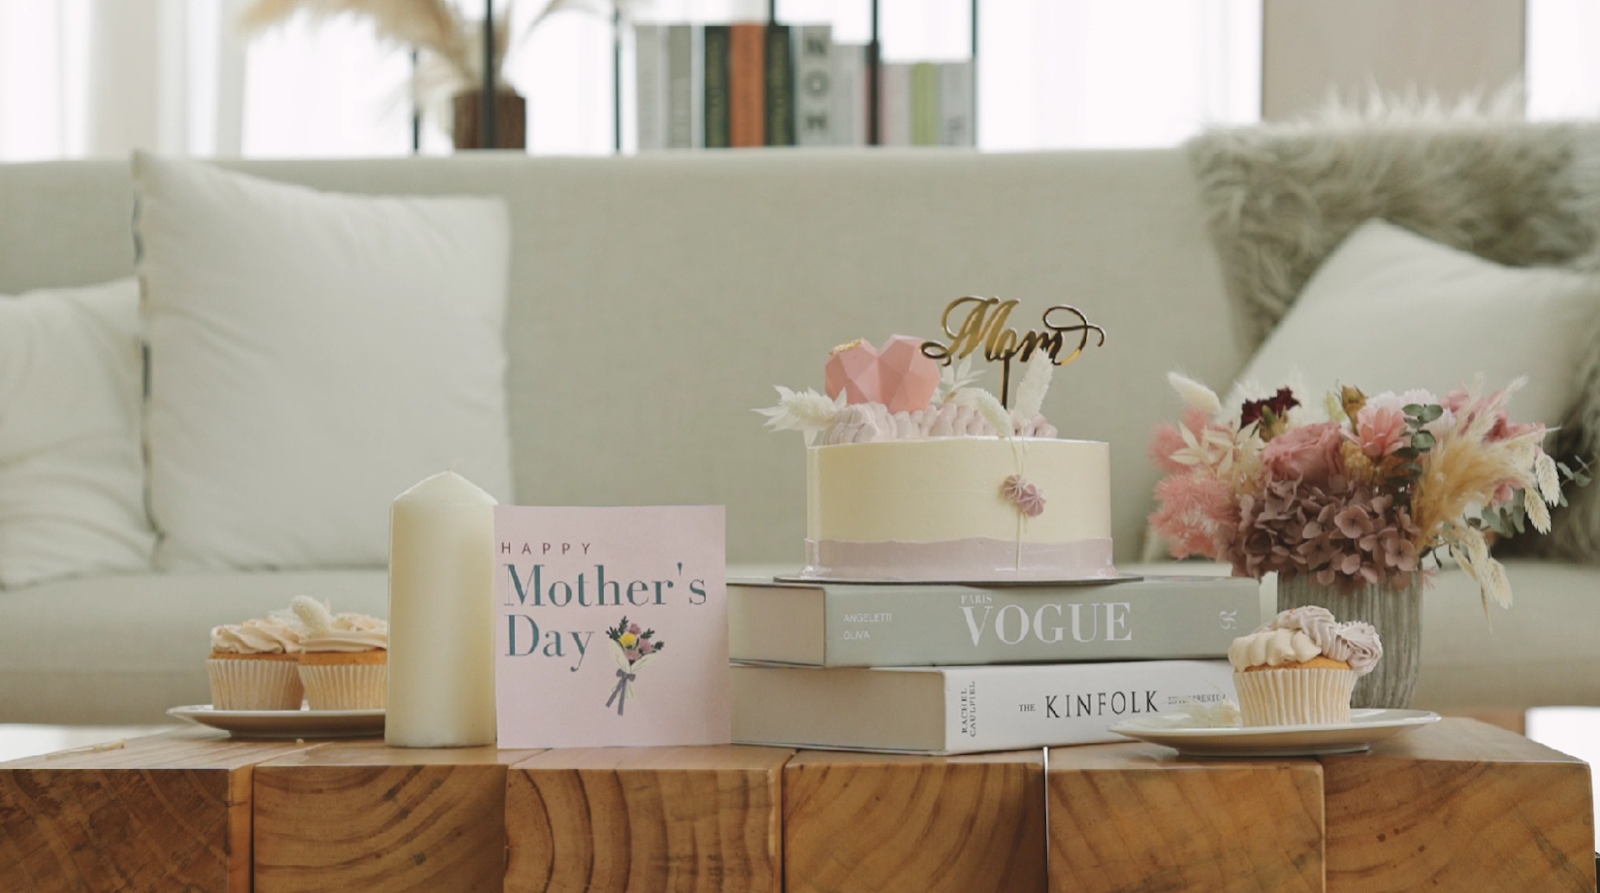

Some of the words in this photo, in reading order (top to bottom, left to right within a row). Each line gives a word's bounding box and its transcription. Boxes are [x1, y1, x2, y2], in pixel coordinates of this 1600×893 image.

[919, 294, 1106, 366] Mom
[501, 541, 592, 555] HAPPY
[503, 562, 707, 607] Mother's
[960, 594, 993, 604] PARIS
[843, 612, 893, 623] ANGELETTI
[843, 630, 871, 640] OLIVA
[958, 602, 1133, 647] VOGUE
[504, 614, 595, 672] Day
[960, 687, 968, 734] RACHEL
[1018, 703, 1036, 712] THE
[1045, 690, 1159, 718] KINFOLK
